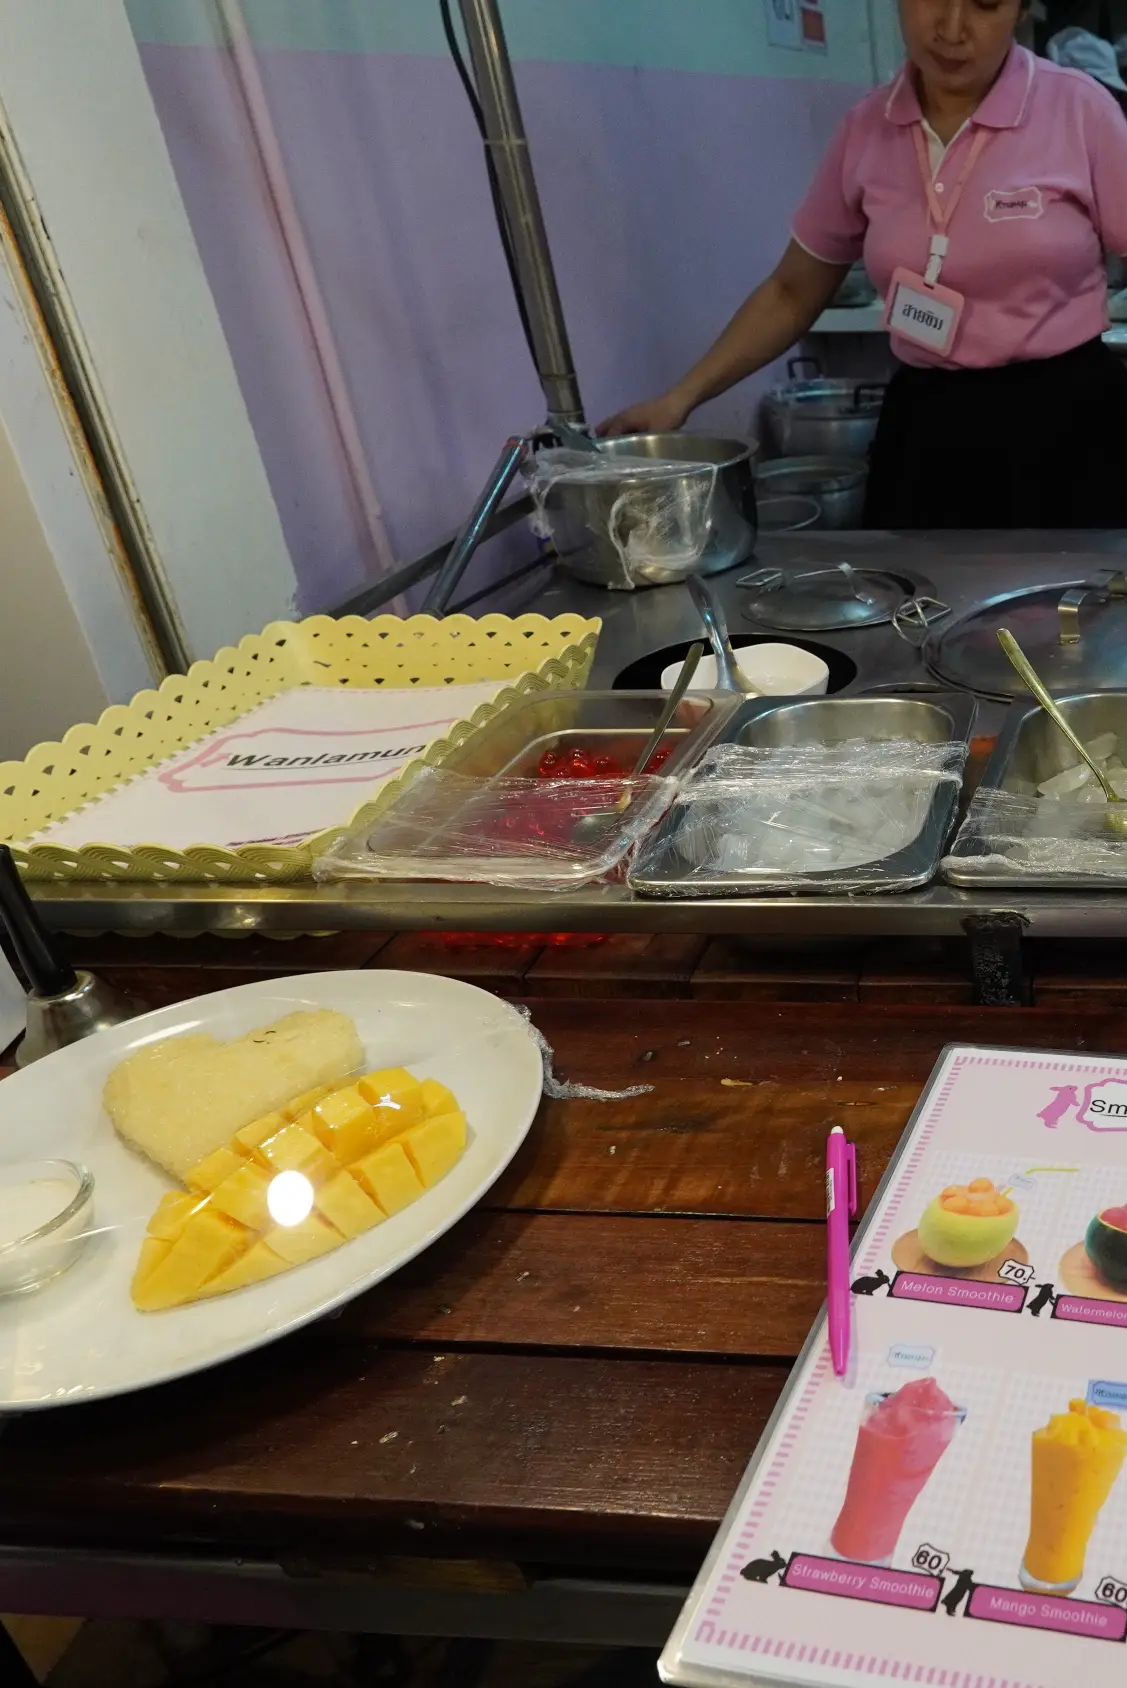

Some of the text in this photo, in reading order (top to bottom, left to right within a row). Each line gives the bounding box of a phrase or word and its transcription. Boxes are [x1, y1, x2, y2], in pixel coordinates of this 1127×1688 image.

[226, 744, 426, 767] Wanlamun
[900, 1280, 1014, 1305] Melon Smoothie
[791, 1563, 935, 1599] Strawberry Smoothie
[989, 1596, 1108, 1627] Mango Smoothie
